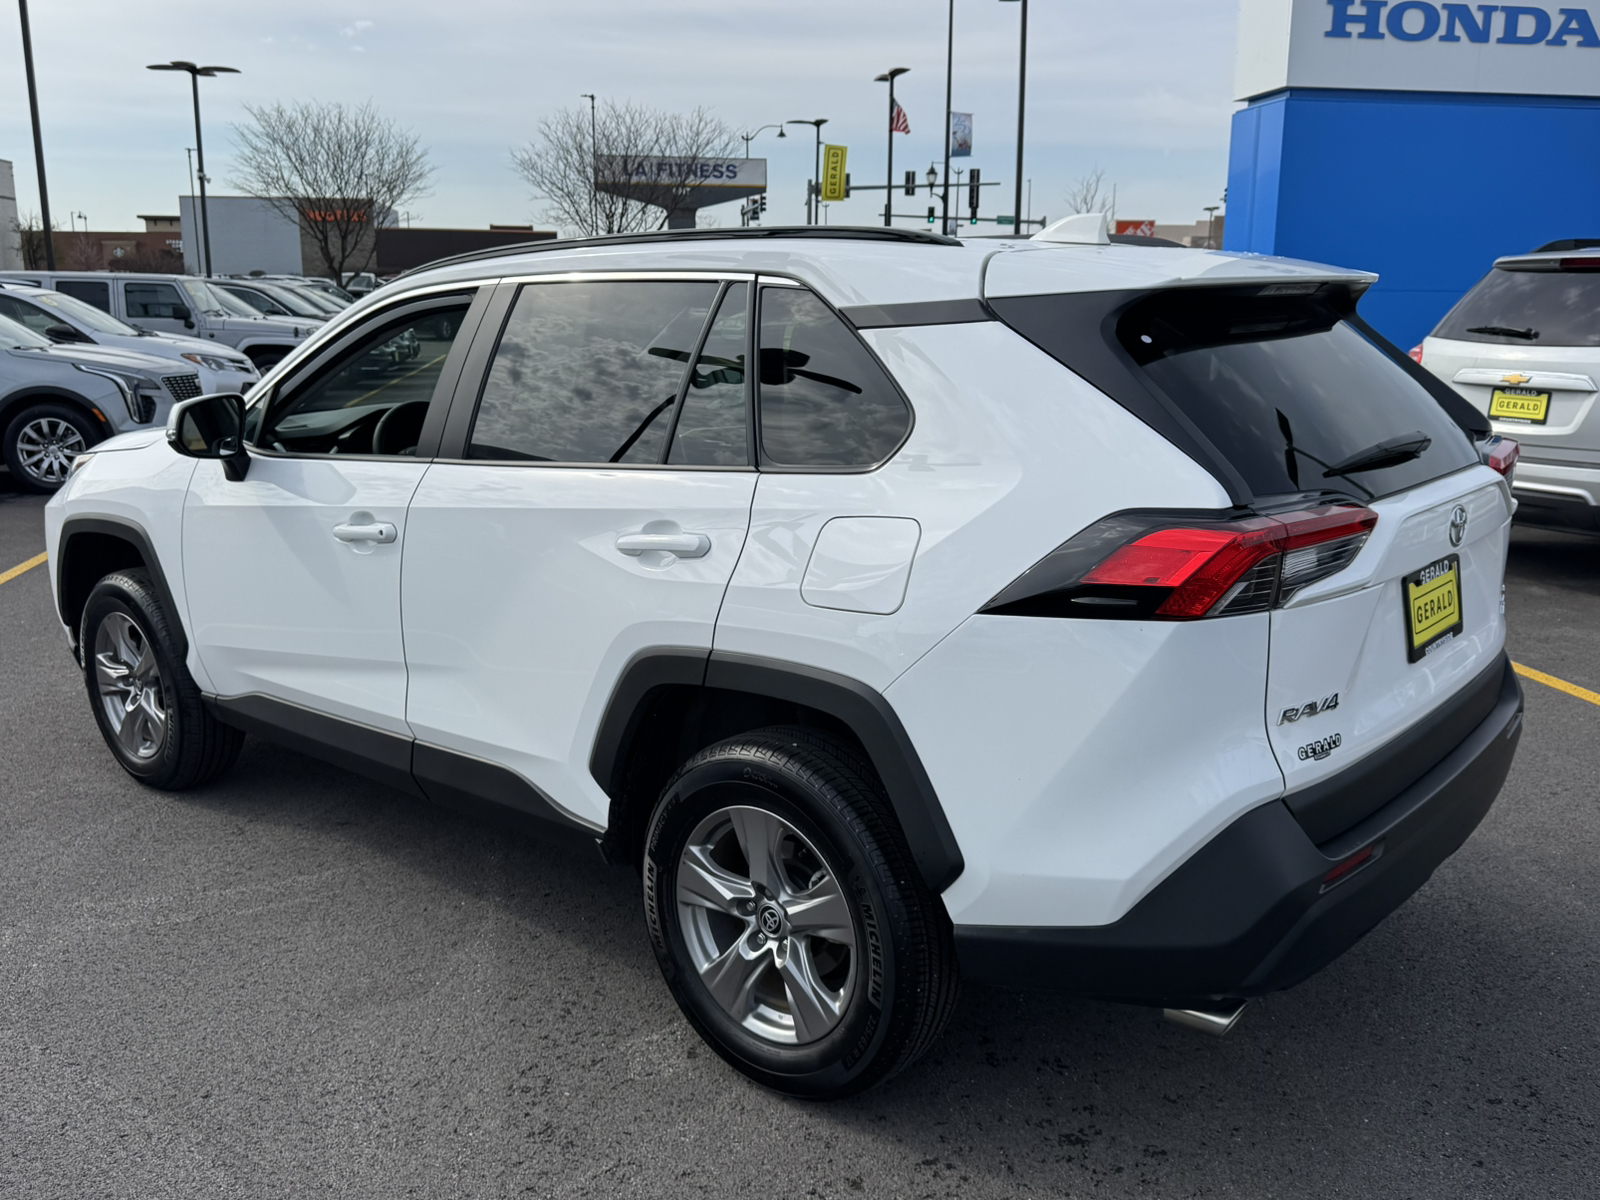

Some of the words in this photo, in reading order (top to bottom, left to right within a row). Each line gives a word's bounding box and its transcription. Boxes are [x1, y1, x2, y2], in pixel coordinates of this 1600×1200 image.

[1324, 0, 1600, 48] HONDA
[624, 160, 648, 178] LA
[656, 162, 738, 180] FITNESS
[828, 151, 839, 195] GERALD
[1498, 400, 1540, 412] GERALD
[1504, 388, 1538, 396] GERALD
[1420, 559, 1450, 586] GERALD
[1416, 589, 1453, 624] GERALD
[1276, 691, 1339, 727] RAV4
[1298, 733, 1342, 761] GERALD
[650, 811, 668, 852] PRIMACY
[645, 862, 664, 950] MICHELIN
[861, 902, 884, 1005] MICHELIN
